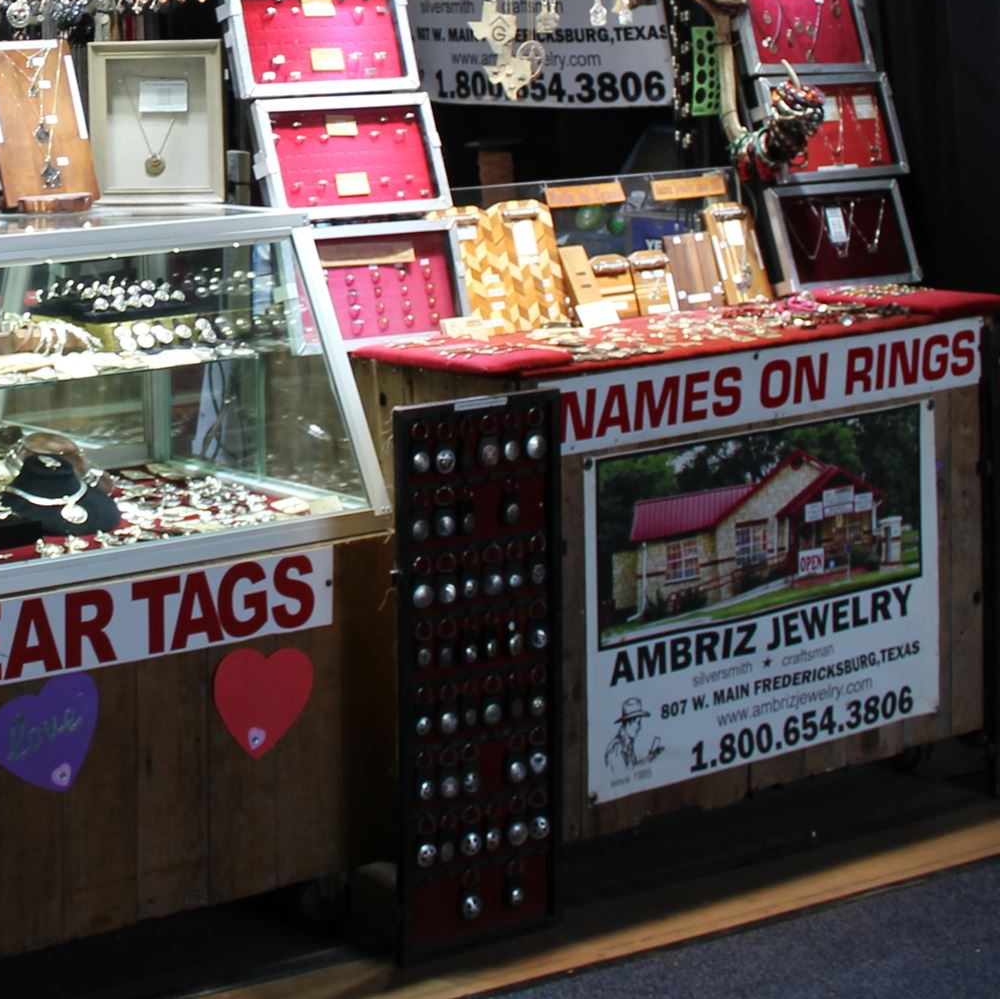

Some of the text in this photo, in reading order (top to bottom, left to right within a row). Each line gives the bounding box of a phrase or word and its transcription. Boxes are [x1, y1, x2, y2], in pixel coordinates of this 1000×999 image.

[435, 69, 667, 104] 1.800654.3806
[561, 329, 975, 443] NAMES ON RINGS
[131, 554, 316, 655] TAGS
[610, 584, 913, 687] AMBRIZ JEWELRY
[692, 643, 834, 688] silversmith craftsman
[660, 699, 688, 720] 807
[692, 694, 710, 711] W.
[713, 682, 750, 707] MAIN
[690, 685, 914, 773] 1.800.654.3806
[716, 675, 873, 727] www.ambrizjewelry.com
